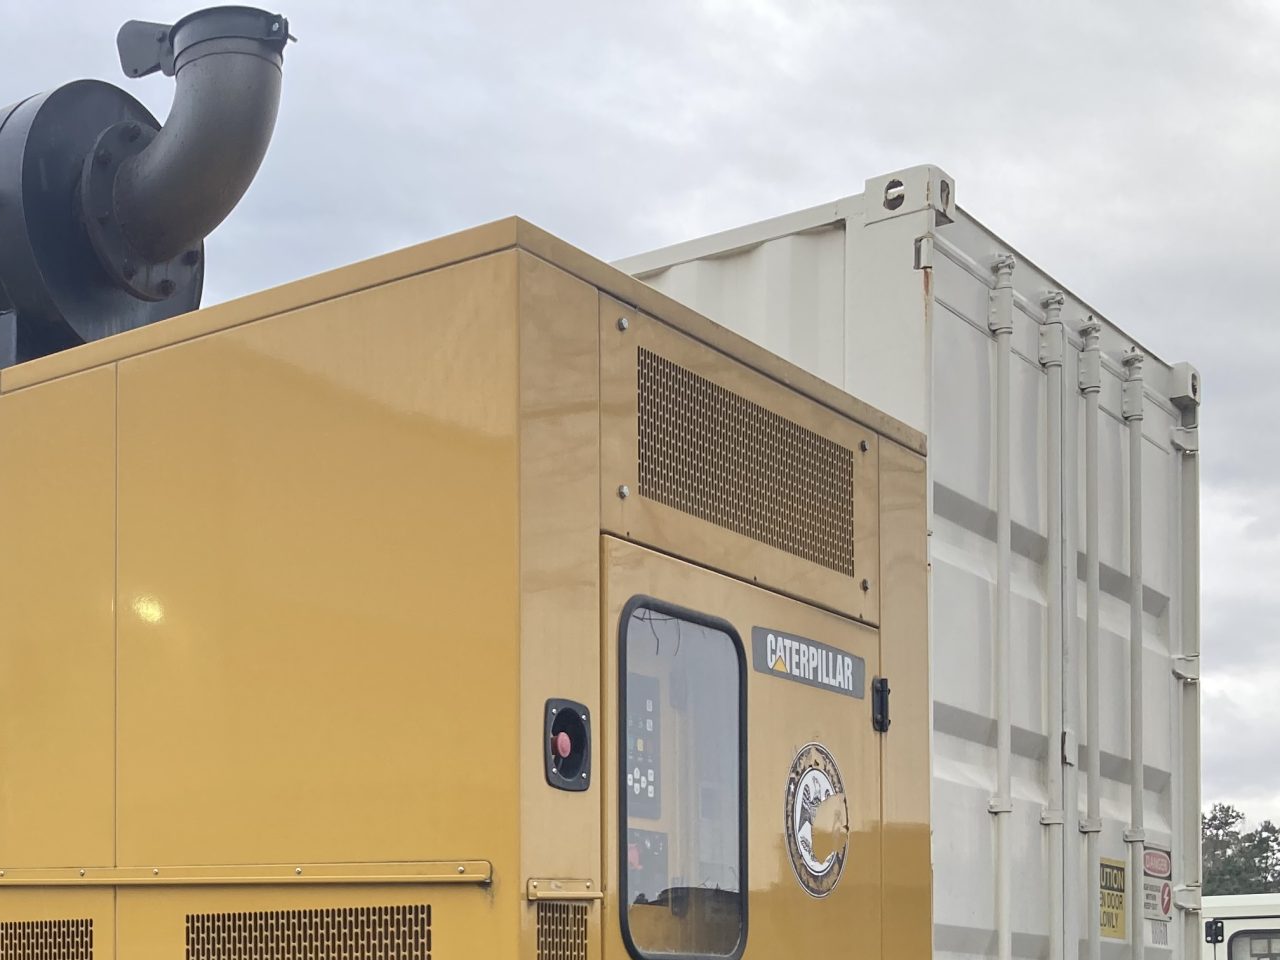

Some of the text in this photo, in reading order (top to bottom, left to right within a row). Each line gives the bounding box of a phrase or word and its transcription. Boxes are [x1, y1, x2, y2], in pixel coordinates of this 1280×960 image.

[766, 633, 853, 691] CATERPILLAR
[1100, 867, 1124, 890] UTION
[1100, 911, 1119, 929] LOWLY
